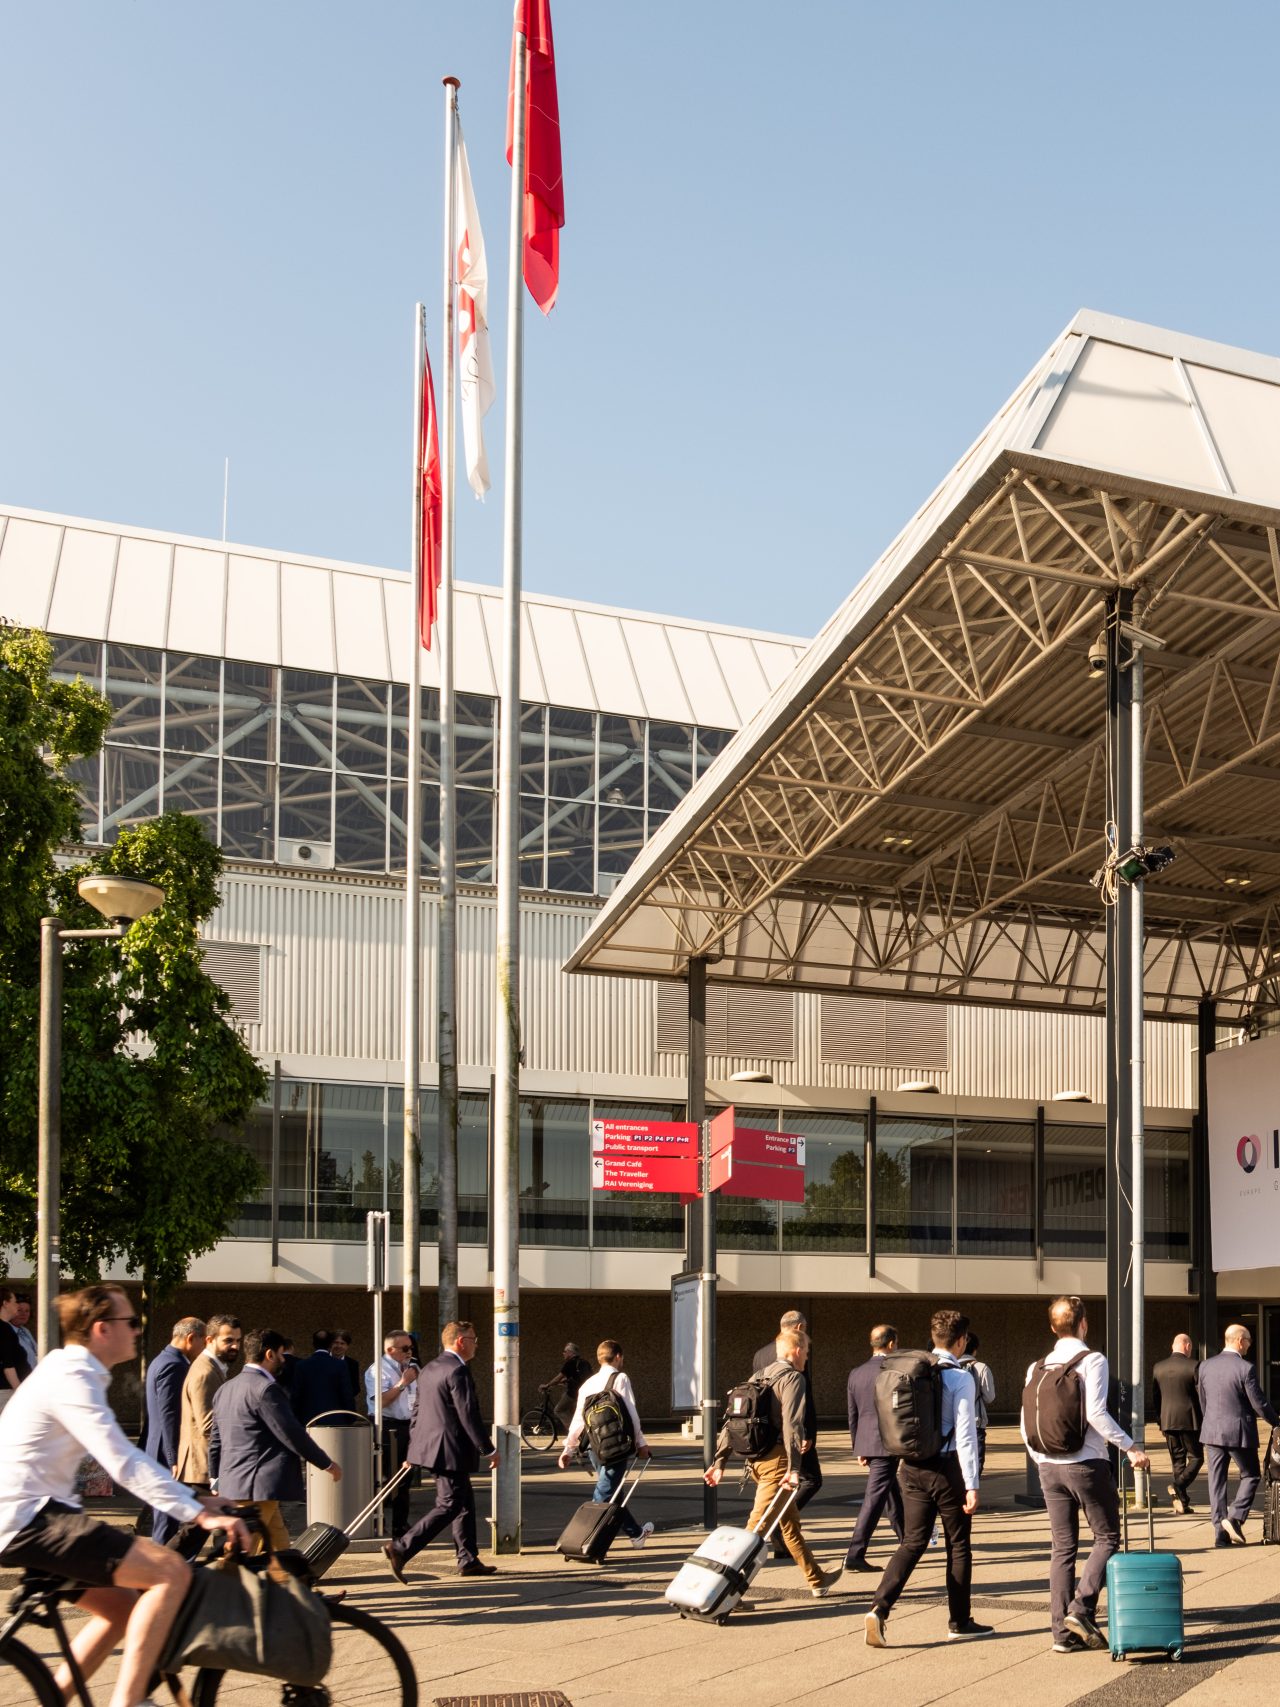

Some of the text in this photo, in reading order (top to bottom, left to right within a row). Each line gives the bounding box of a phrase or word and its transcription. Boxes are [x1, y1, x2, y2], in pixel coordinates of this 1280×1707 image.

[605, 1134, 631, 1142] Parking
[765, 1134, 789, 1143] Entrance
[627, 1144, 659, 1152] transport
[765, 1144, 787, 1153] Parking
[720, 1143, 732, 1178] 1
[619, 1170, 649, 1178] Traveller
[618, 1181, 654, 1189] Vereniging
